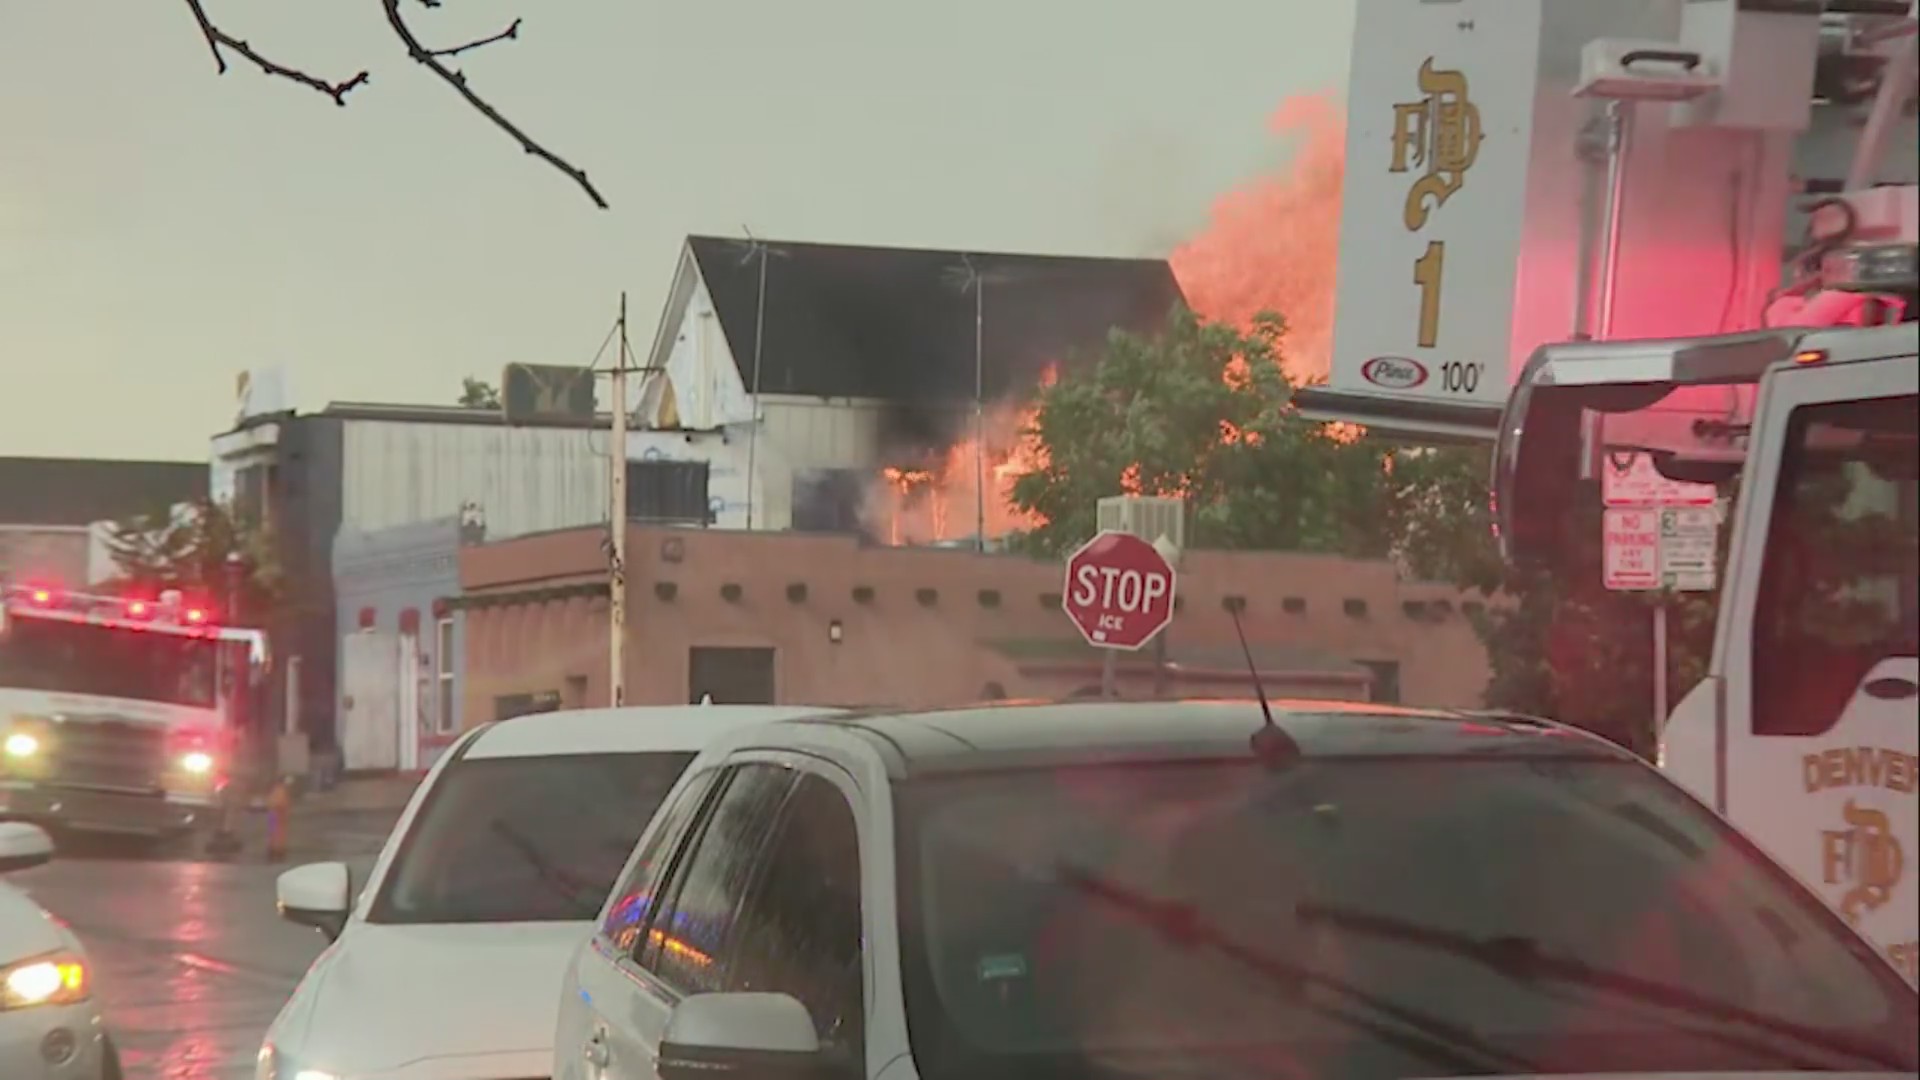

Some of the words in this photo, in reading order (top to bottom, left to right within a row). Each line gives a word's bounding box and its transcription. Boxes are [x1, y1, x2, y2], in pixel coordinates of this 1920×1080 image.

[1413, 240, 1445, 348] 1
[1073, 563, 1167, 614] STOP
[1098, 613, 1124, 631] ICE
